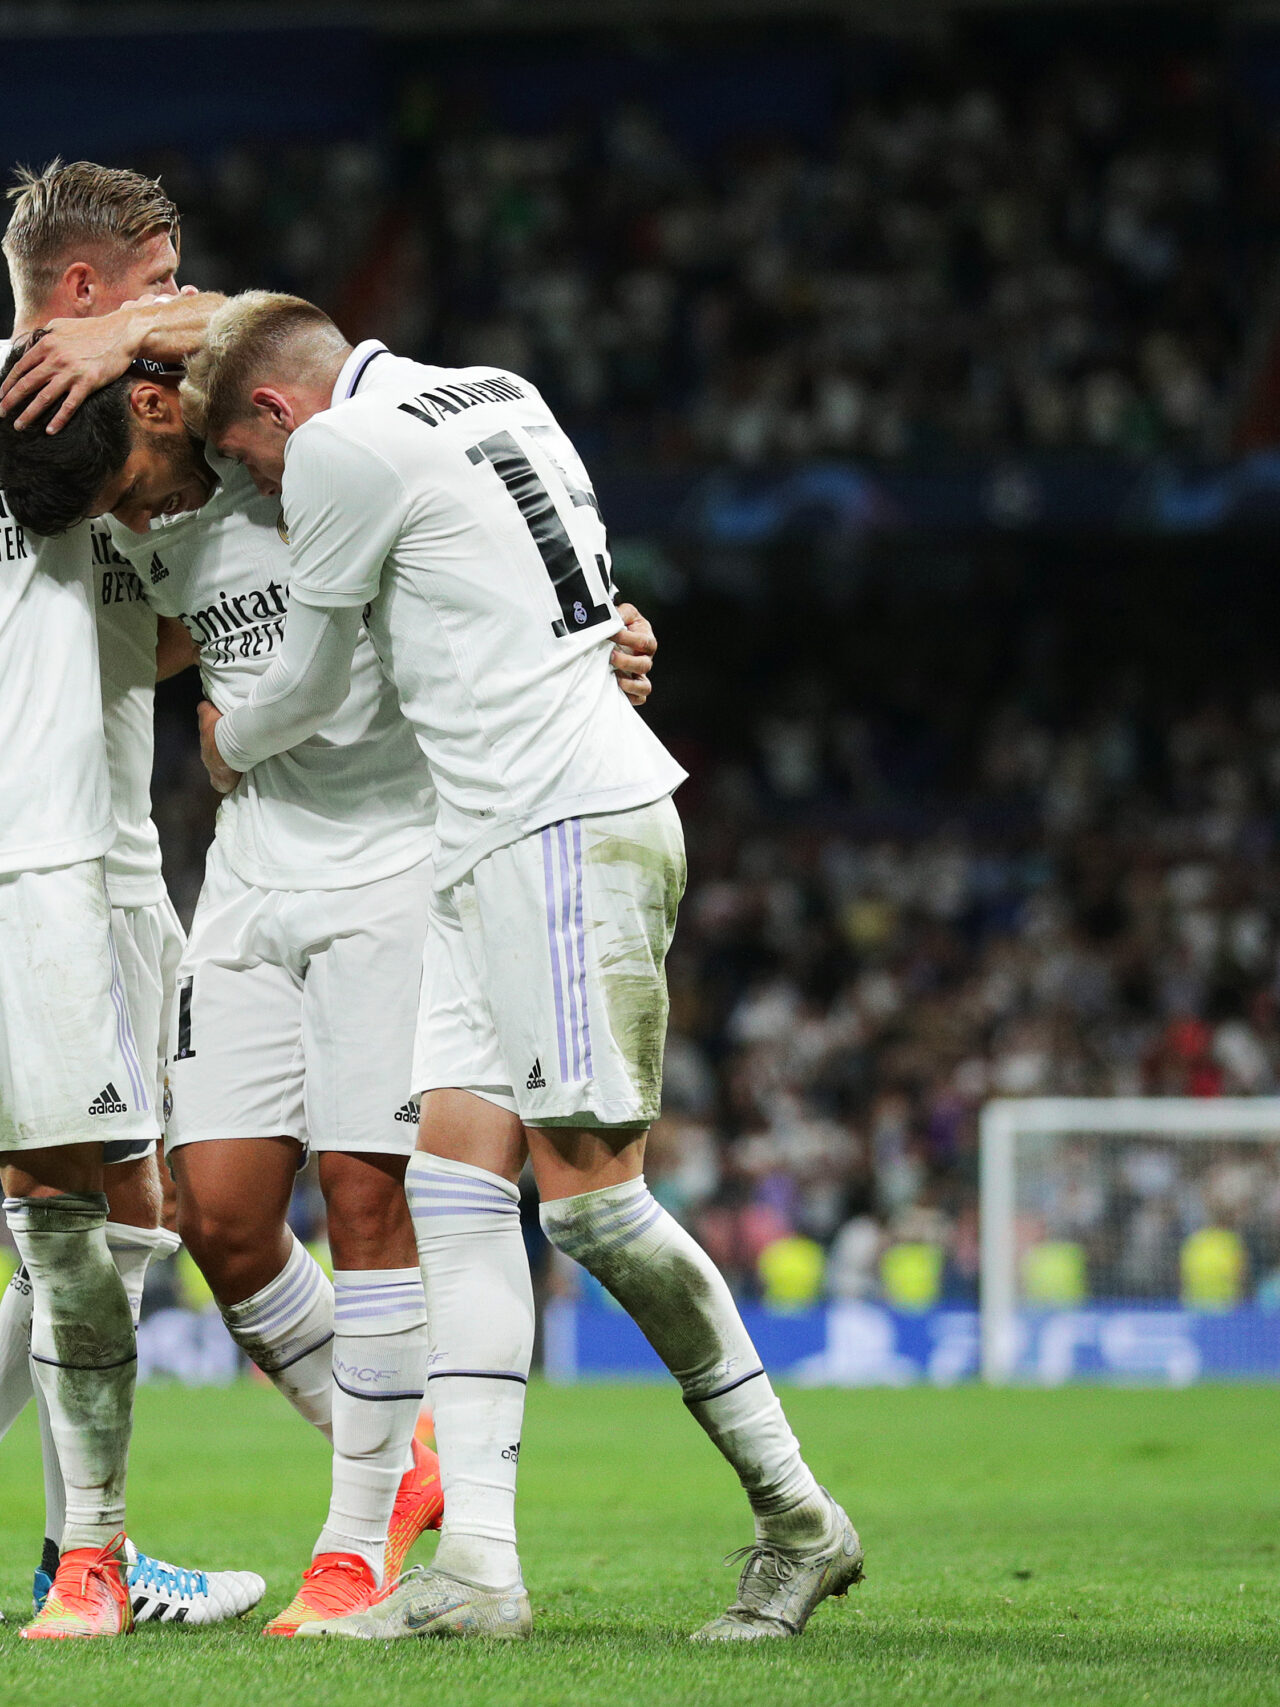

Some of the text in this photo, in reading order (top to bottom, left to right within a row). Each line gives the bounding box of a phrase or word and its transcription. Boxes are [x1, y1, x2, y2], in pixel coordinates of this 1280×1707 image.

[178, 580, 290, 646] mirat
[240, 619, 285, 658] BETT
[88, 1100, 128, 1115] adidas
